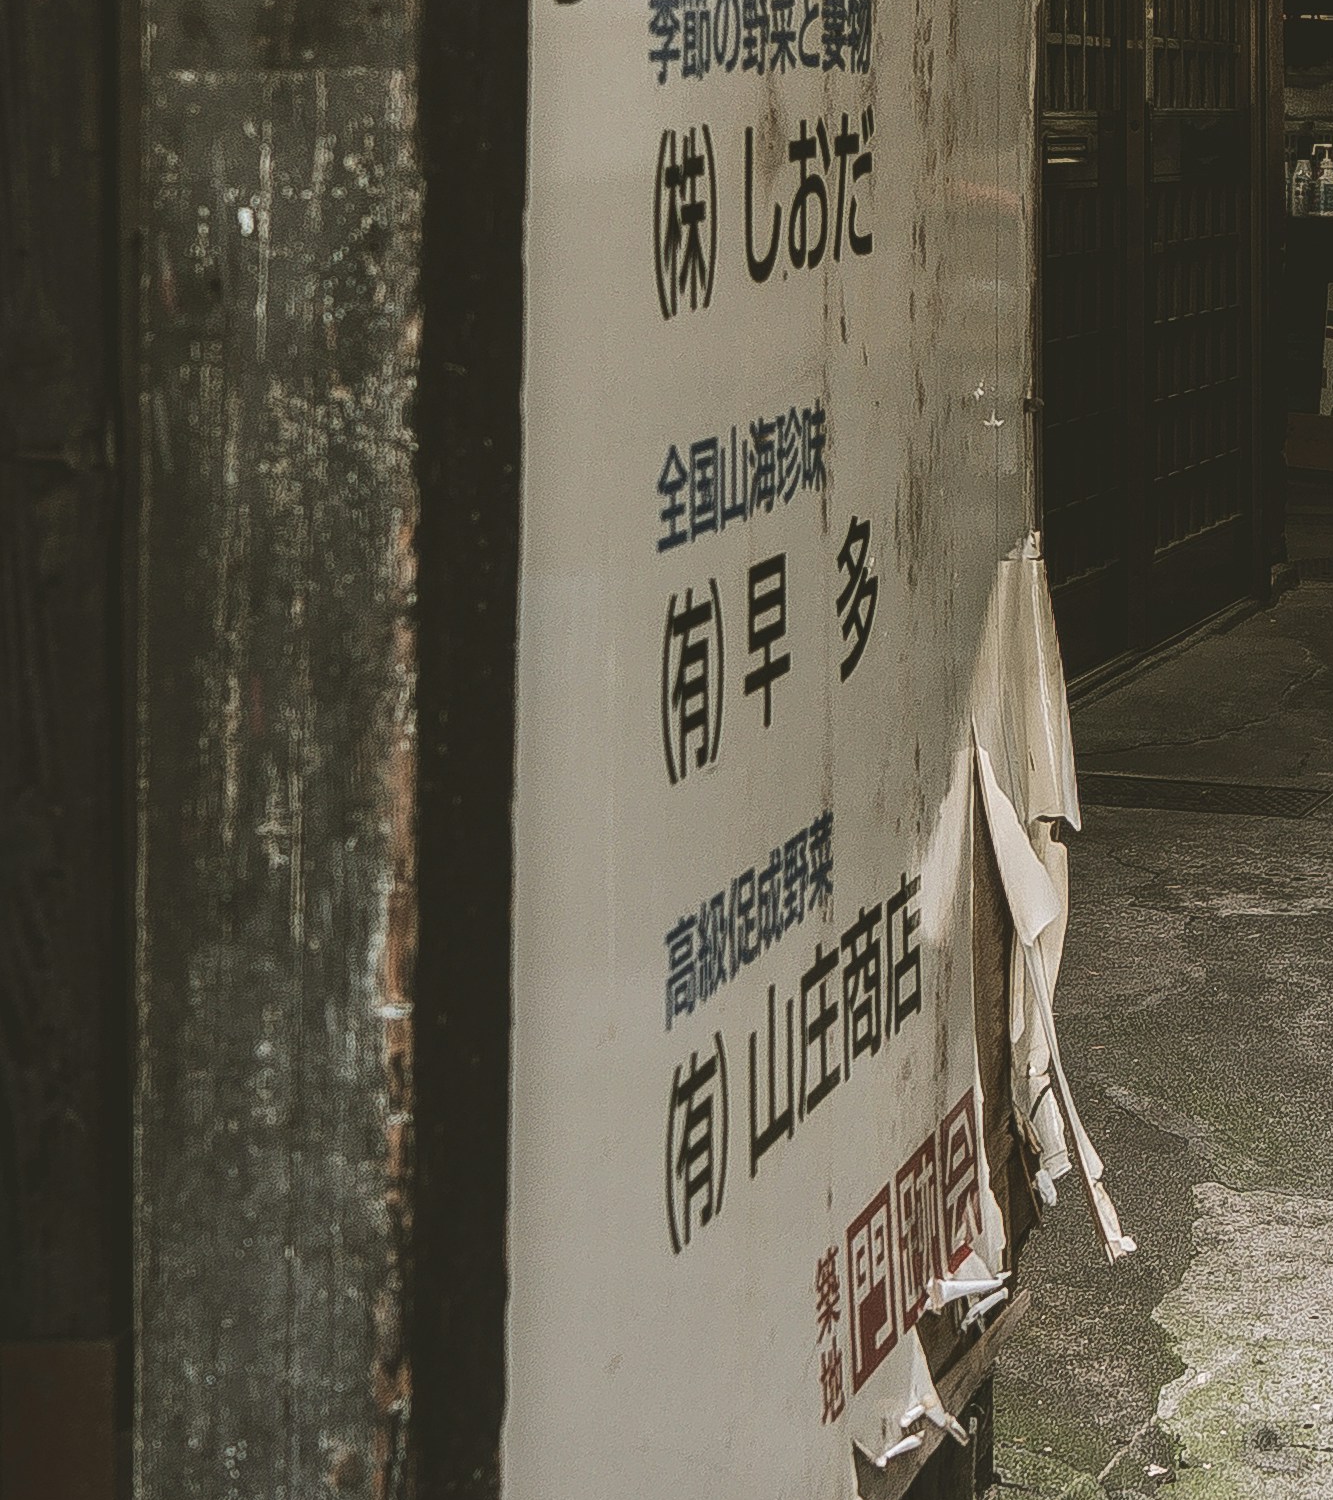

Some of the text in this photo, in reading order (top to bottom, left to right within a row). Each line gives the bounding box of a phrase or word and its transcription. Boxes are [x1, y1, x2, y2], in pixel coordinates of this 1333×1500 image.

[657, 397, 827, 553] 全国山海珍味
[665, 809, 834, 1032] 高級促成野菜
[815, 1246, 845, 1427] 築地
